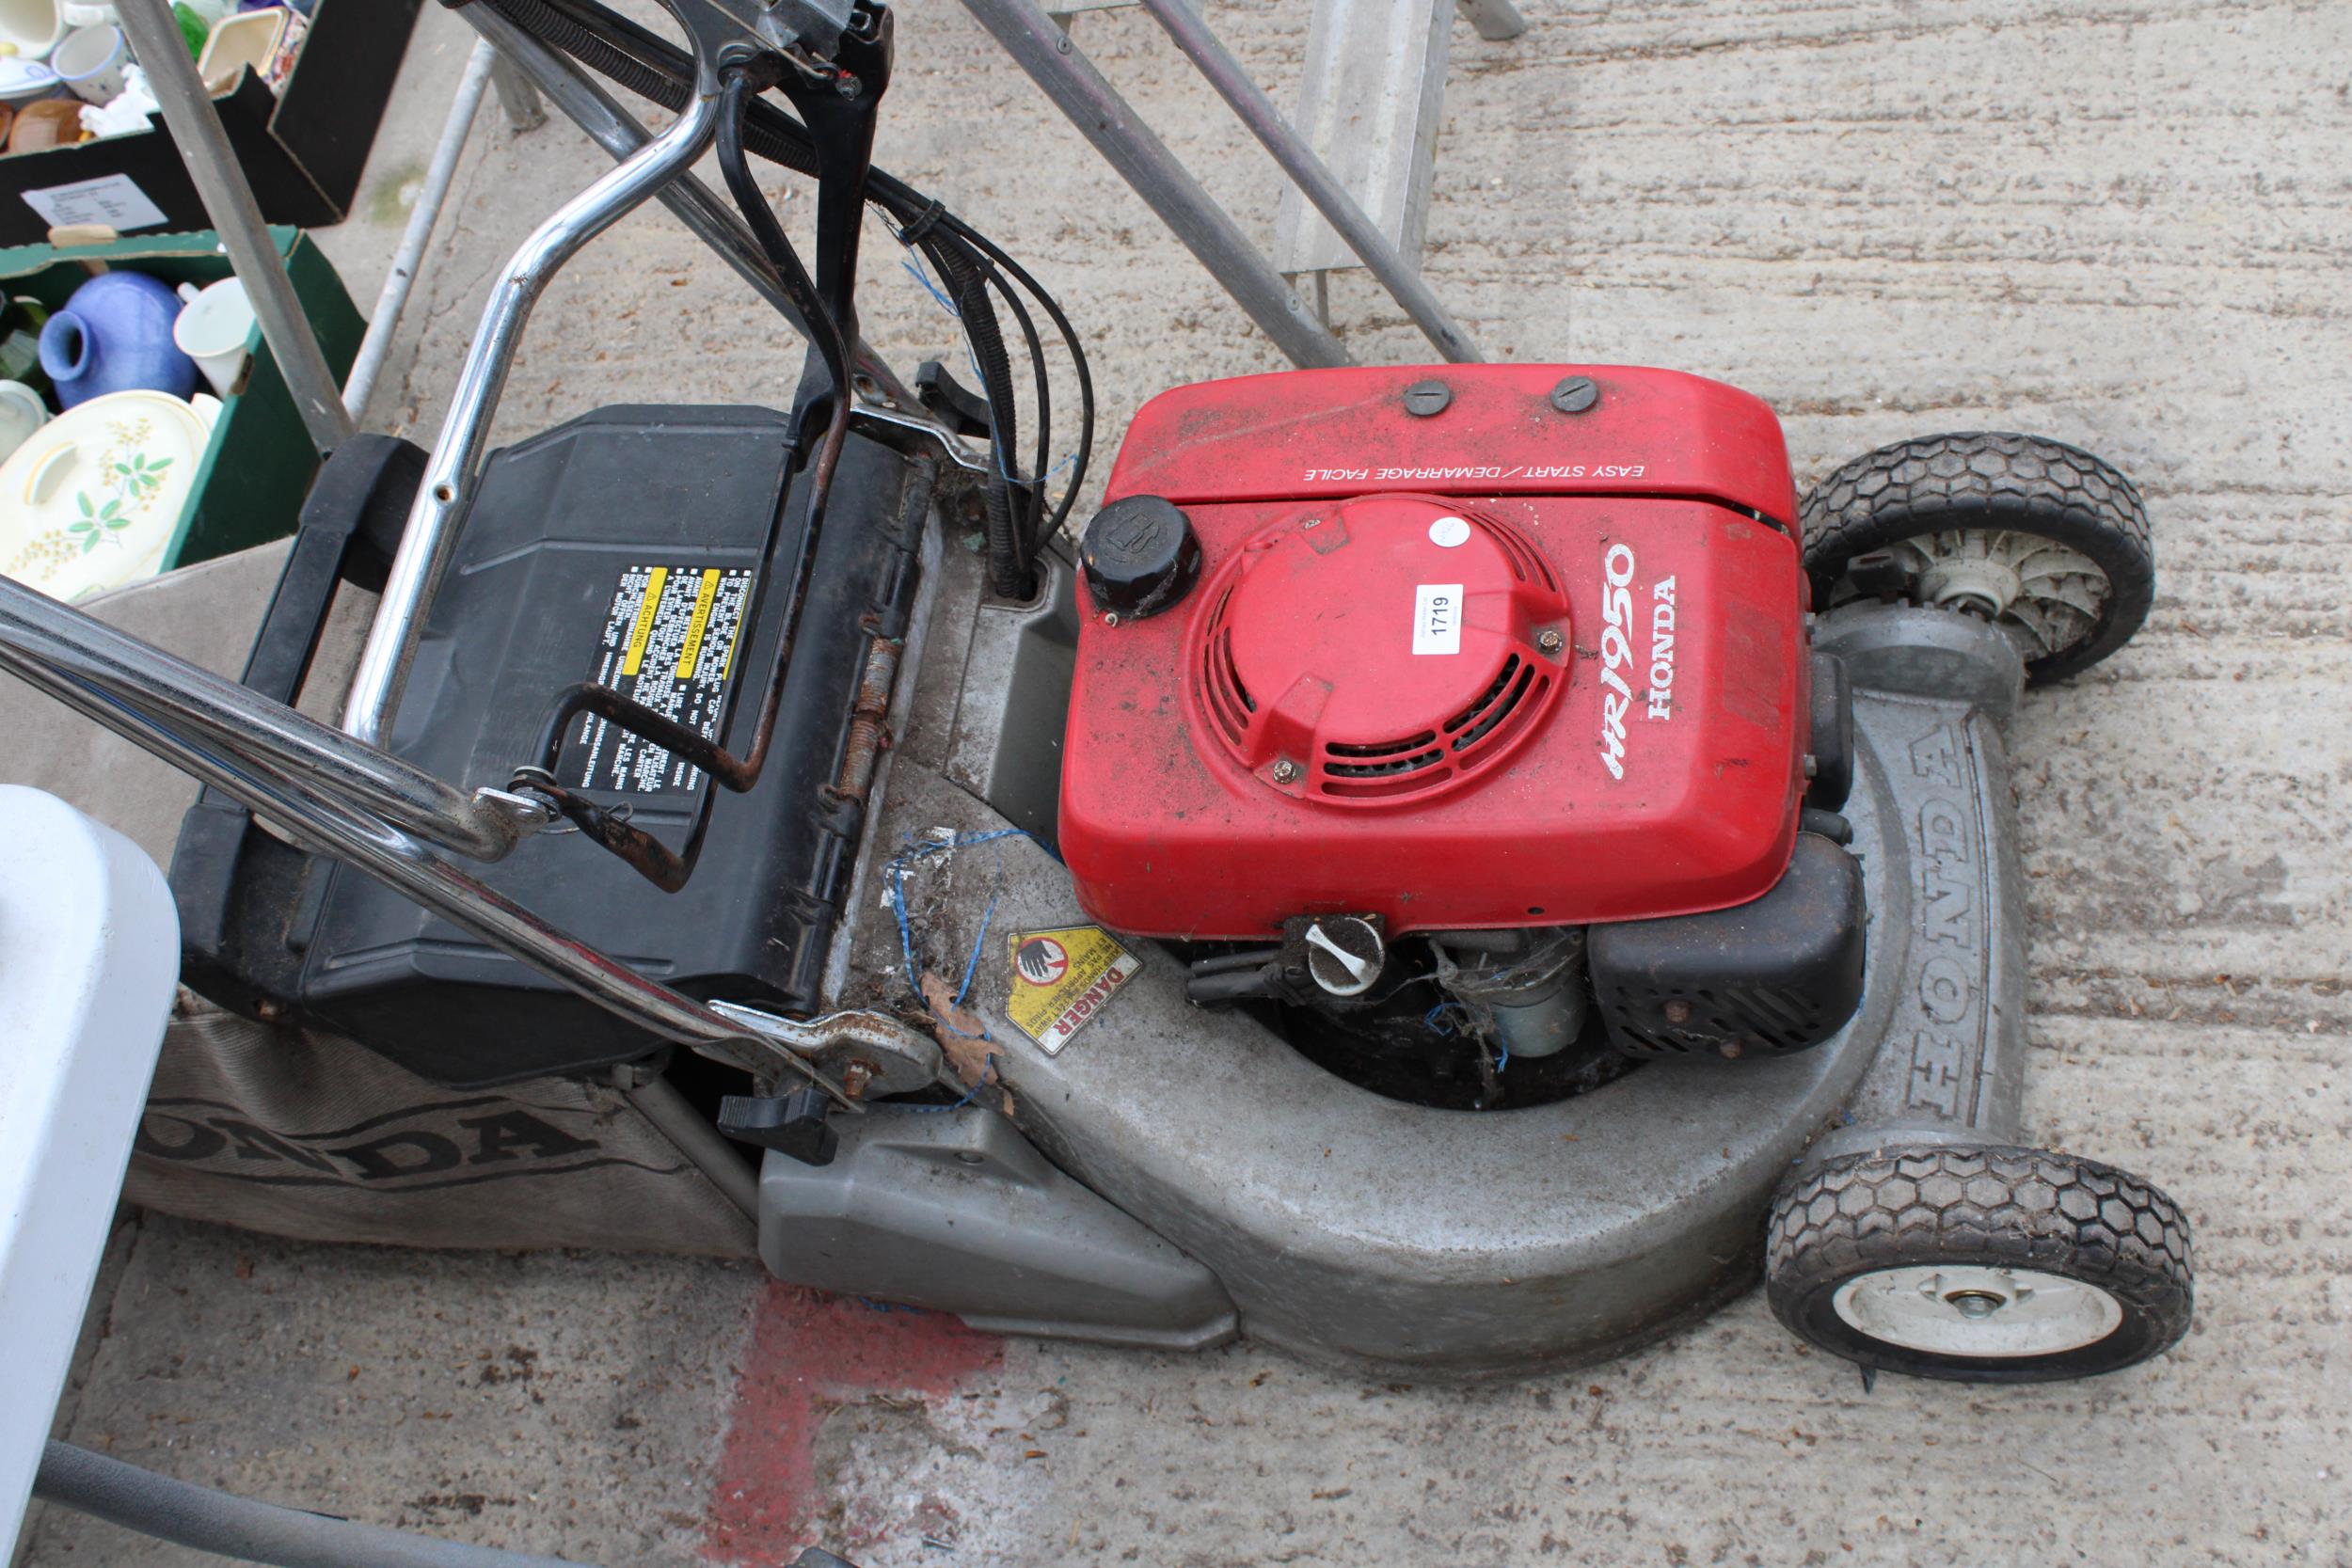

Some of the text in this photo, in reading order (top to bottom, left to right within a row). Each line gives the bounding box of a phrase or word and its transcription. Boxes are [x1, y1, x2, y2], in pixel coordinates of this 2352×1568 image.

[1302, 468, 1368, 482] FACILE
[1591, 465, 1645, 478] EASY
[624, 574, 635, 593] NICHT
[640, 575, 649, 587] VOR
[670, 576, 681, 594] POUR
[679, 576, 688, 584] DE
[683, 576, 694, 597] AVANT
[690, 576, 702, 597] AVANT
[715, 577, 726, 596] WHEN
[725, 578, 734, 586] TO
[623, 574, 643, 620] DURCHLESEN.
[662, 597, 675, 620] EVITER
[686, 602, 694, 610] DE
[716, 592, 730, 622] PREVENT
[731, 578, 749, 620] DISCONNECT
[601, 574, 628, 644] DER MOTOR LÄUFT.
[614, 599, 628, 626] ÖFFNEN
[707, 603, 720, 627] ENGINE
[1431, 596, 1449, 636] 1719
[621, 592, 644, 651] INBETRIEBNAHME
[632, 605, 652, 647] ACHTUNG
[656, 624, 667, 641] TOUT
[677, 616, 691, 643] METTRE
[682, 593, 709, 665] AVERTISSEMENT
[706, 578, 740, 683] ON THE BLADE OR MOWER.
[725, 626, 736, 639] THE
[608, 632, 618, 646] UND
[644, 629, 658, 654] QUAND
[658, 614, 676, 660] DEBRANCHER
[706, 627, 721, 657] SERIOUS
[1647, 575, 1676, 721] HONDA
[641, 659, 649, 668] LE
[645, 644, 661, 678] ACCIDENT
[663, 652, 674, 665] DES
[674, 648, 681, 657] LA
[691, 645, 707, 681] RUNNING.
[718, 644, 730, 667] SPARK
[1600, 543, 1635, 780] HR1950
[654, 666, 661, 674] LA
[661, 662, 678, 698] TONDEUSE
[642, 682, 650, 691] NE
[653, 671, 668, 702] TRAVAUX
[710, 673, 723, 692] PLUG
[674, 692, 684, 708] LIRE
[693, 693, 703, 704] DO
[706, 699, 716, 714] CAP
[688, 709, 698, 724] NOT
[622, 748, 632, 761] LES
[647, 743, 656, 752] EN
[611, 743, 626, 776] MARCHE.
[633, 749, 647, 777] CARTER
[614, 767, 627, 789] MAINS
[637, 758, 652, 790] MARCHE.
[653, 779, 661, 788] LE
[672, 762, 685, 786] INSIDE
[1907, 722, 1973, 1121] HONDA
[1087, 953, 1102, 968] PAS
[1052, 966, 1125, 1037] DANGER
[134, 1109, 601, 1180] ONDA
